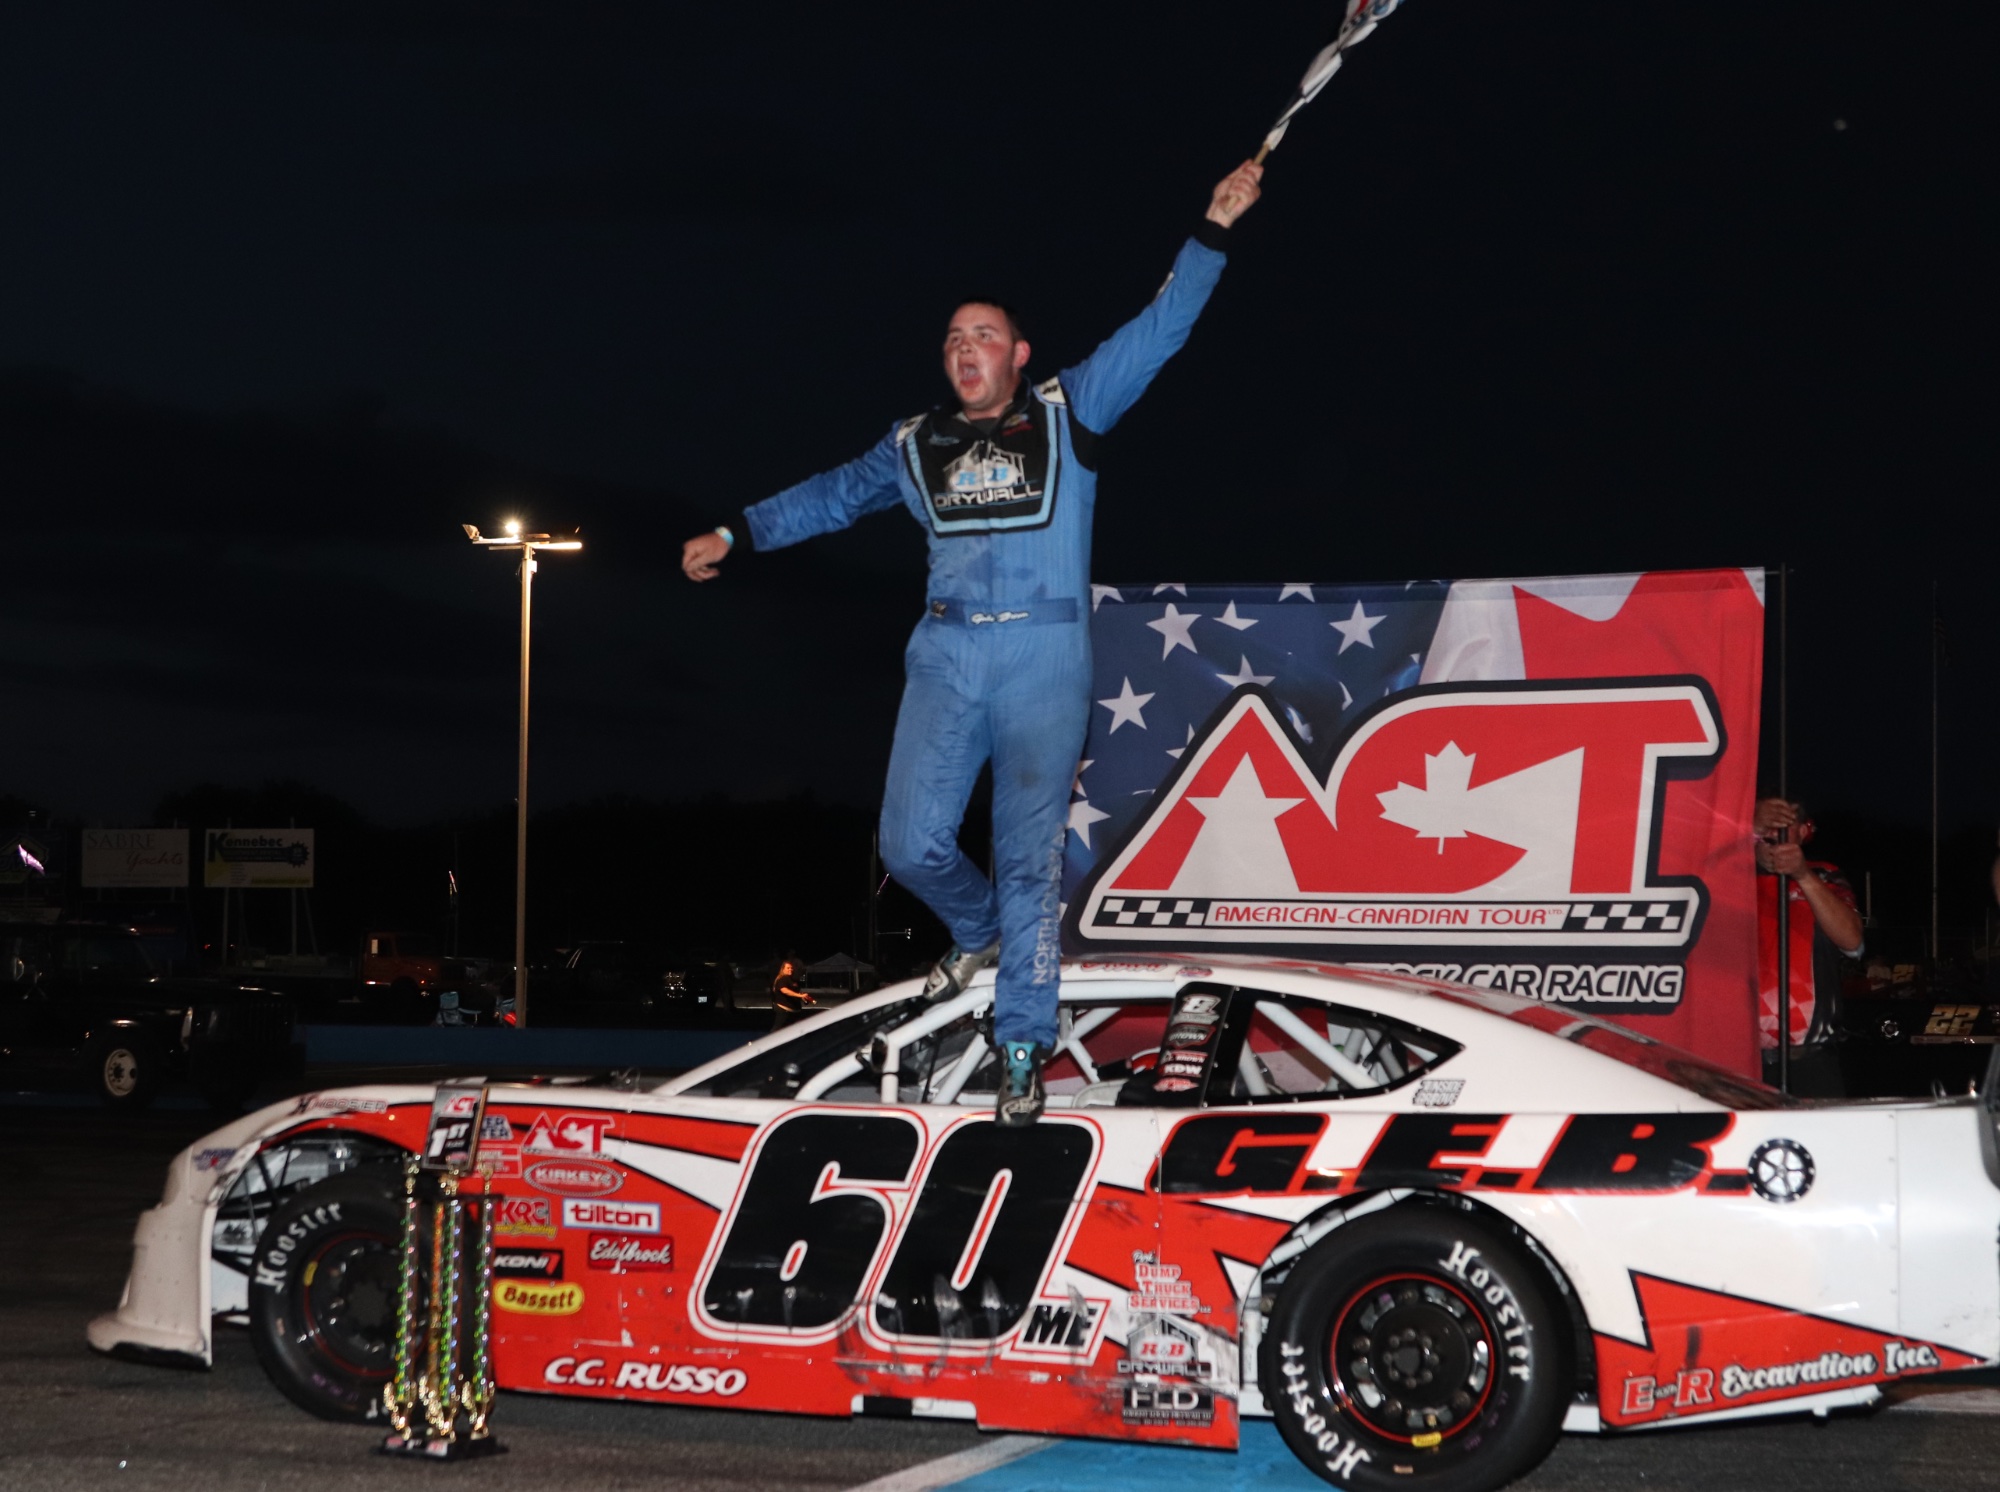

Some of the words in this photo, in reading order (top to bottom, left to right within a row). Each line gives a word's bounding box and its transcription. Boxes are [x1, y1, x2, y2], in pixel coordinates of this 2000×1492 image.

[933, 483, 1043, 508] DRYWALL
[1107, 695, 1713, 895] ACT
[87, 832, 155, 850] SABRE
[207, 832, 284, 861] Kennebec
[126, 851, 185, 872] Yachts
[1214, 905, 1468, 926] AMERICAN-CANADIAN
[1479, 908, 1547, 926] TOUR
[1032, 917, 1055, 985] NORTH
[1467, 969, 1539, 997] CAR
[1547, 969, 1681, 998] RACING
[1922, 1003, 1982, 1035] 22
[522, 1112, 615, 1153] ACT
[535, 1168, 604, 1183] KIRKEY
[495, 1200, 548, 1225] KRC
[570, 1204, 653, 1226] tilton
[698, 1108, 1100, 1346] 60
[253, 1201, 343, 1294] Hoosier
[590, 1238, 672, 1265] Edelbrock
[493, 1254, 550, 1269] KONI
[1138, 1264, 1180, 1278] DUMP
[503, 1287, 575, 1309] Bassett
[1142, 1281, 1190, 1294] TRUCK
[1130, 1294, 1199, 1309] SERVICES
[1439, 1241, 1533, 1383] Hoosier
[1023, 1304, 1098, 1348] ME
[544, 1356, 605, 1387] C.C.
[614, 1361, 748, 1396] RUSSO
[1117, 1359, 1212, 1377] DRYWALL
[1621, 1375, 1656, 1415] E
[1674, 1367, 1715, 1408] R
[1720, 1352, 1878, 1398] Excavation
[1883, 1341, 1941, 1375] Inc.
[1130, 1388, 1200, 1410] FLD
[1280, 1341, 1372, 1480] Hoosier
